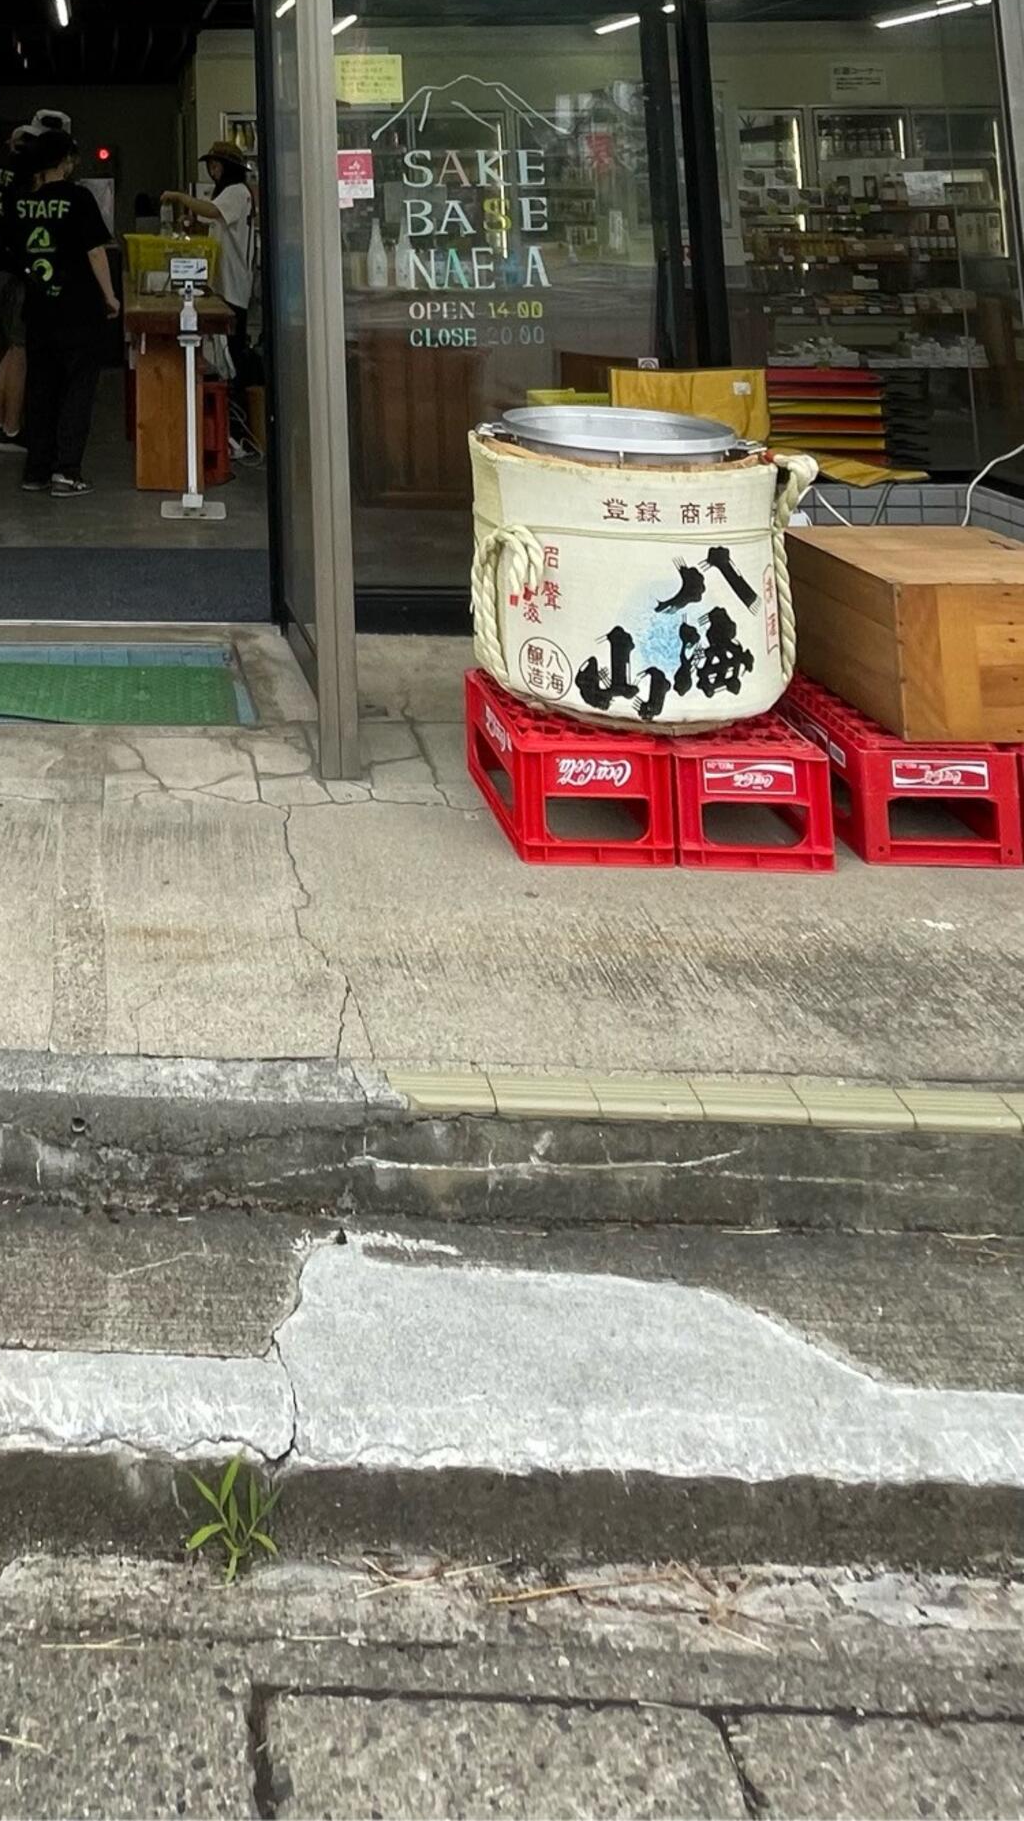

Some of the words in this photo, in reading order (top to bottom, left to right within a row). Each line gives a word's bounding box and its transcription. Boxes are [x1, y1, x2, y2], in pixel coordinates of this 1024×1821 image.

[402, 149, 547, 188] SAKE
[16, 199, 72, 219] STAFF
[402, 196, 549, 237] BASE
[409, 301, 476, 320] OPEN
[410, 327, 477, 348] CLOSE
